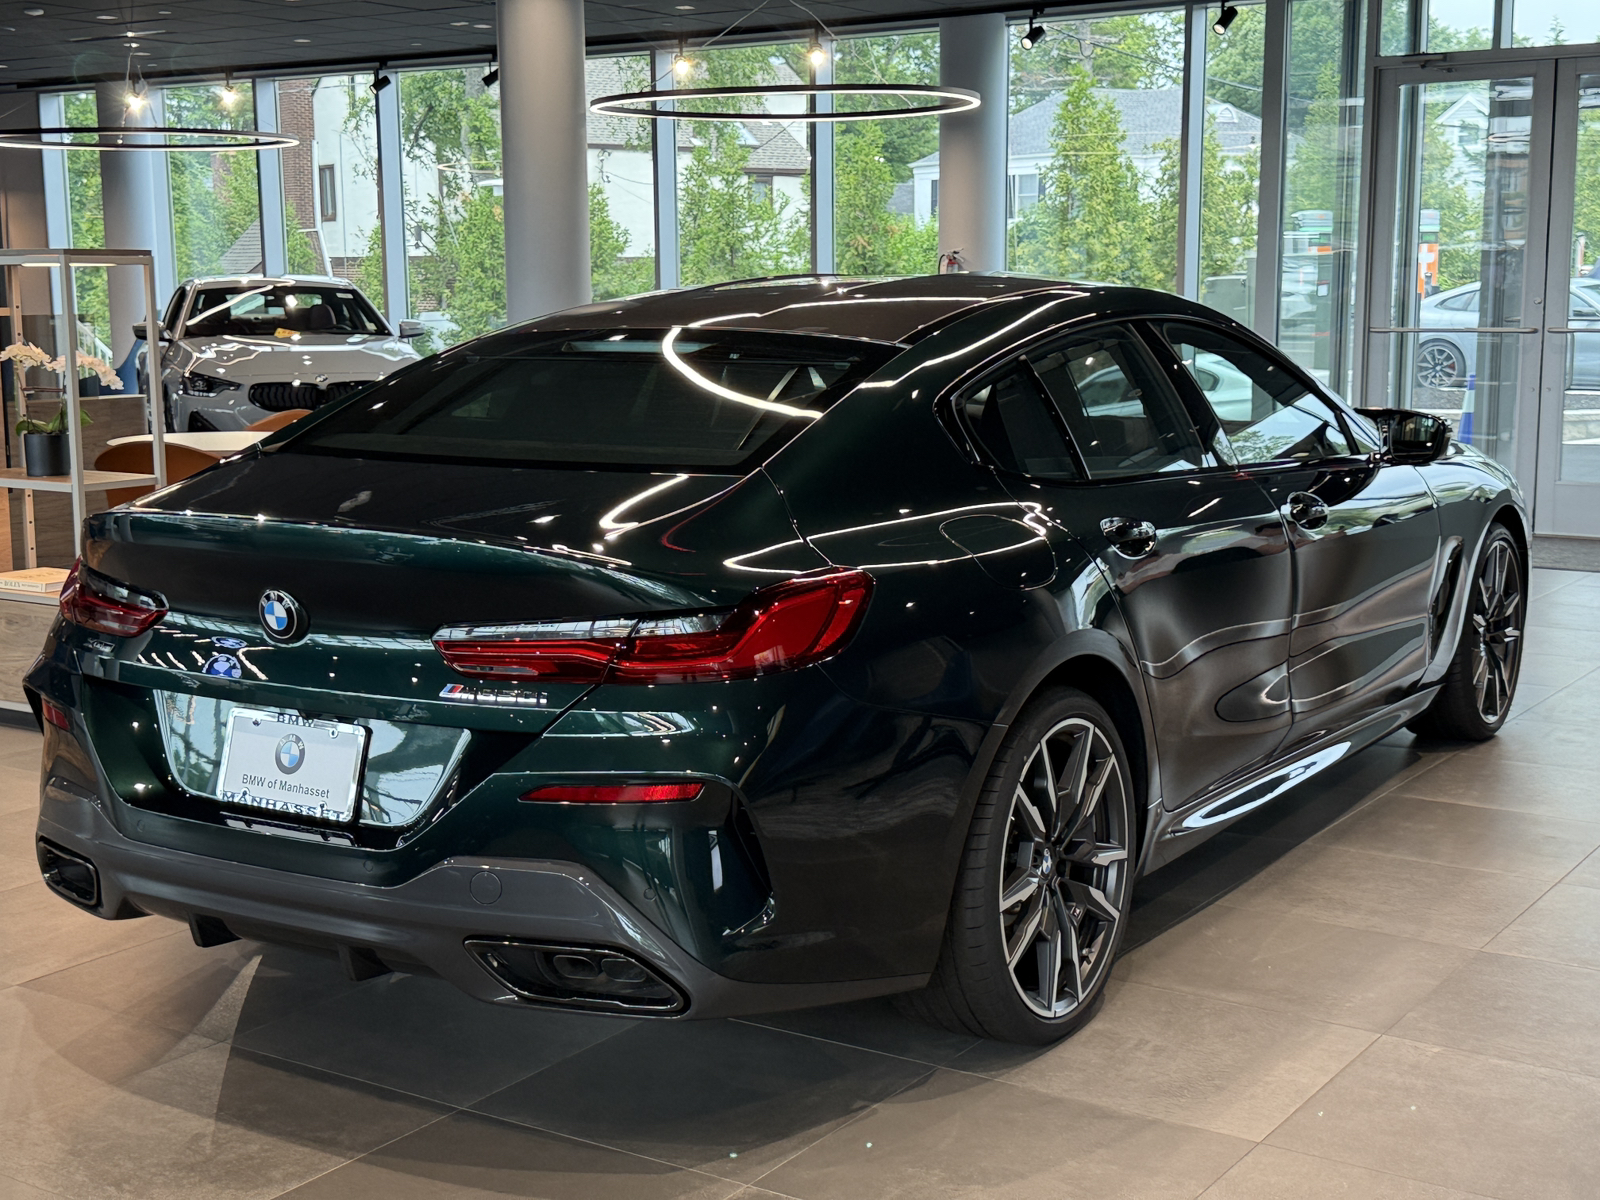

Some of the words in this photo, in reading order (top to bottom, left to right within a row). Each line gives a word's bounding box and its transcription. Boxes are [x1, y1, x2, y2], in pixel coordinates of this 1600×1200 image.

[277, 713, 314, 728] BMW
[242, 774, 266, 787] BMW
[267, 779, 278, 790] of
[278, 780, 330, 799] Manhasset
[222, 790, 346, 820] MANHASSET
